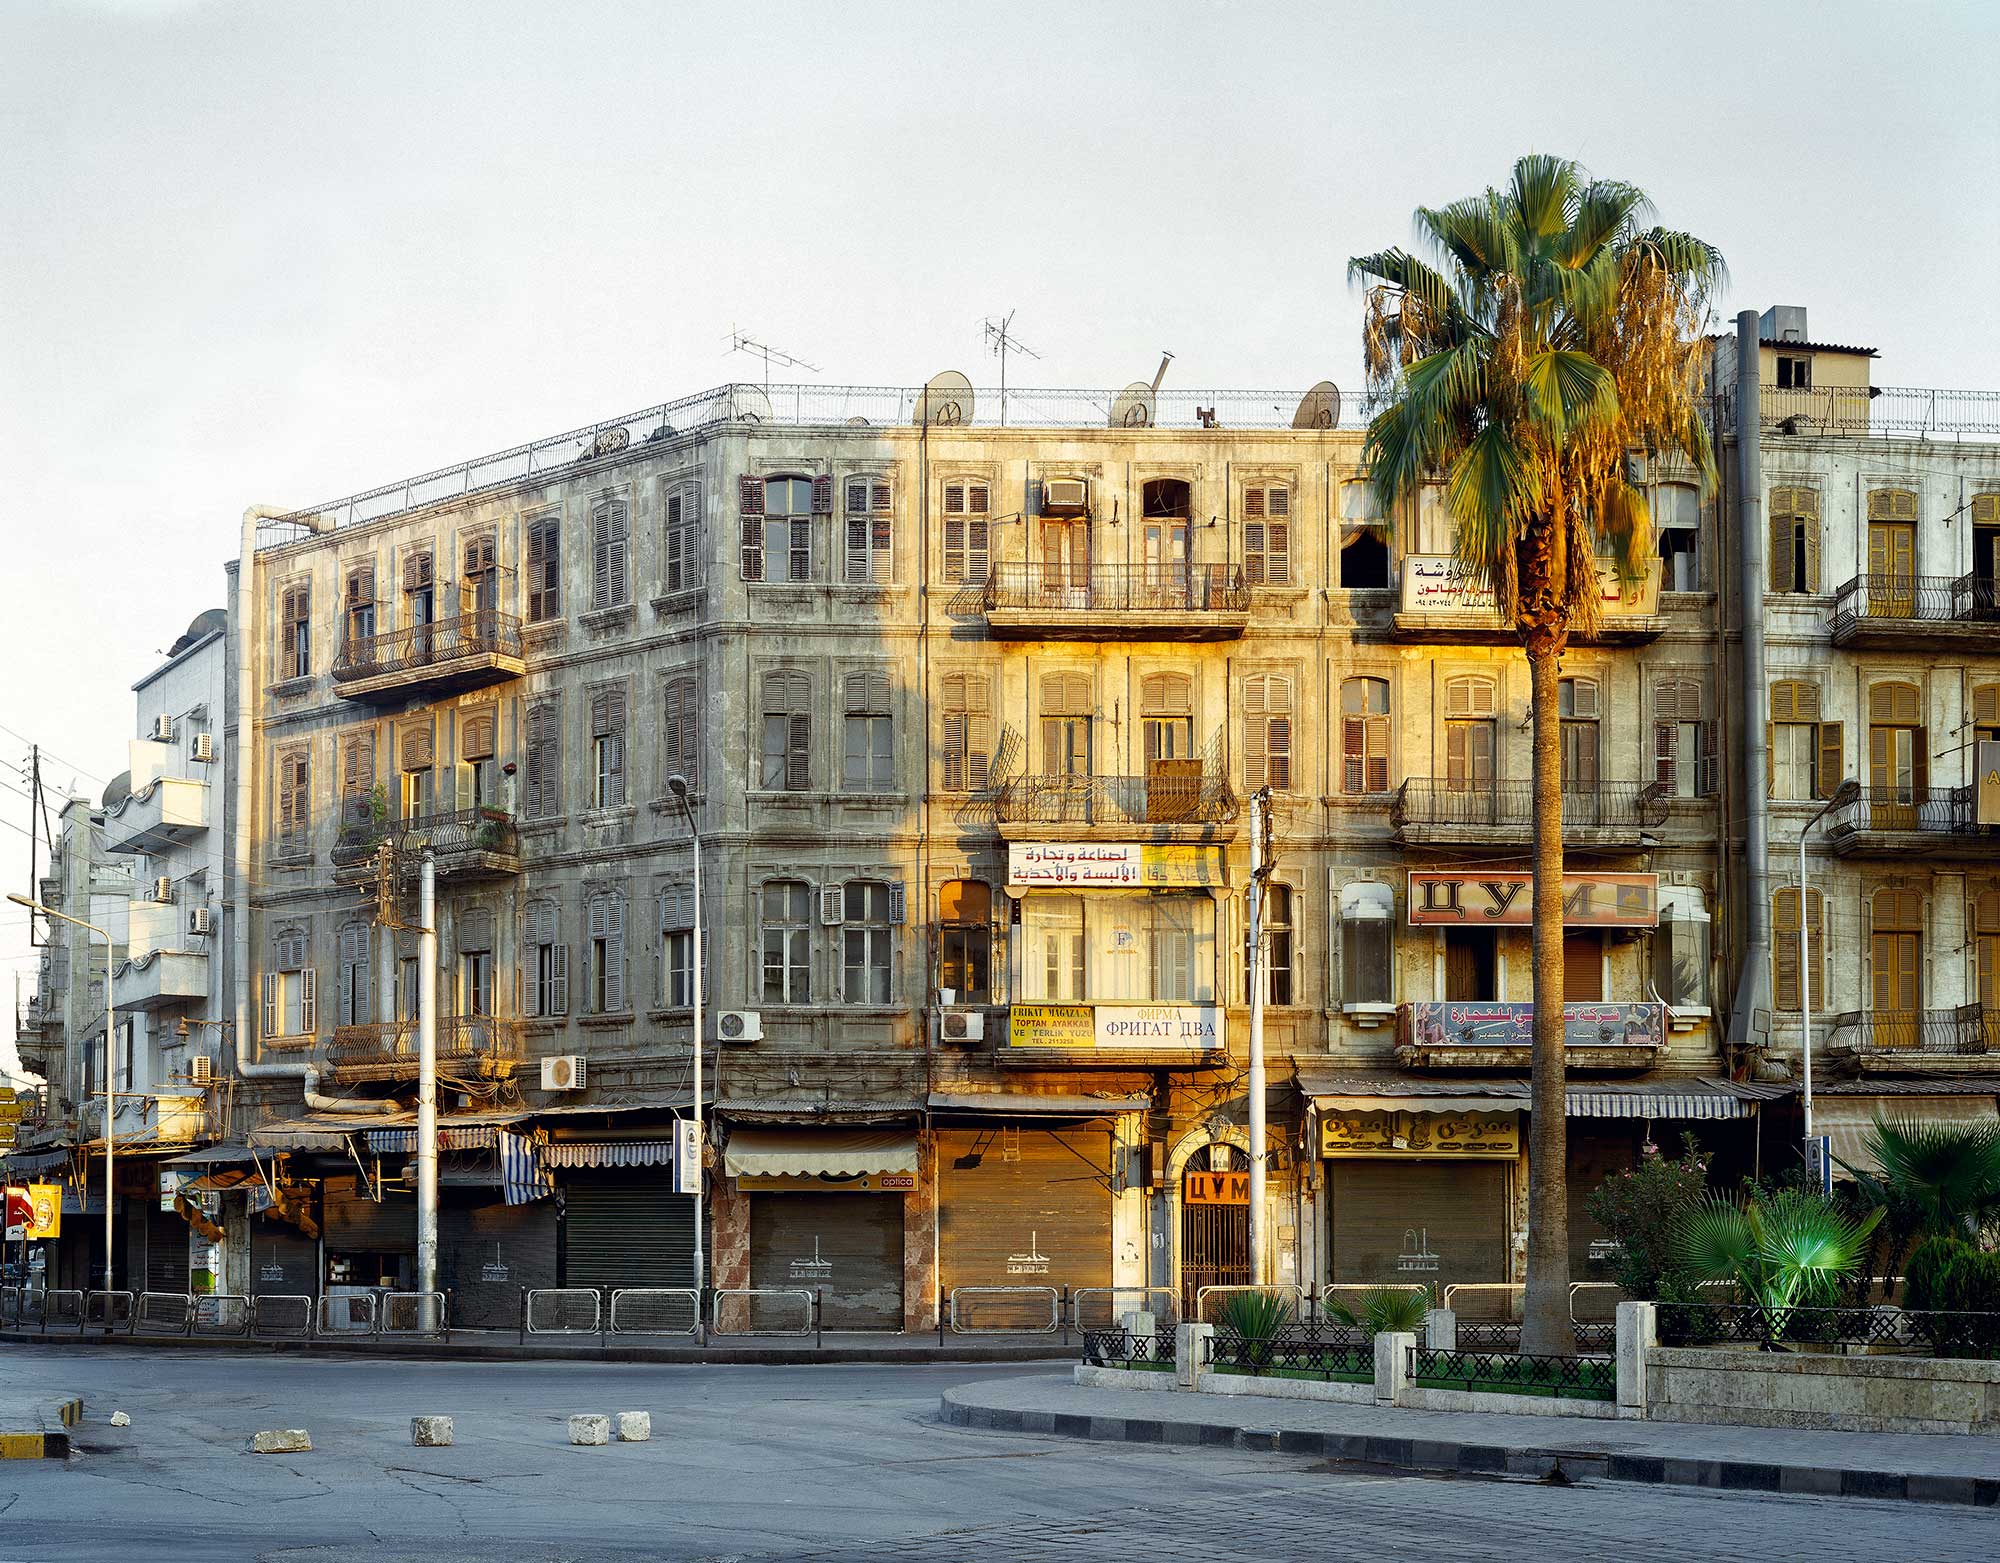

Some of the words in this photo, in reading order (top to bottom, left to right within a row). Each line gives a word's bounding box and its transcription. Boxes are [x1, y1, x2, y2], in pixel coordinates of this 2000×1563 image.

[1078, 848, 1127, 861] لصناعة
[1013, 864, 1078, 882] والأحذية
[1083, 864, 1136, 882] الألبسة
[1137, 1008, 1182, 1020] ФИРМА
[1451, 1006, 1512, 1025] للتجارة
[1579, 1006, 1621, 1025] شركة
[1015, 1019, 1047, 1027] TOPTAN
[1106, 1022, 1172, 1036] ФРИГАТ
[1180, 1021, 1216, 1039] ДВА
[1013, 1029, 1025, 1037] VE
[882, 1176, 913, 1187] optica
